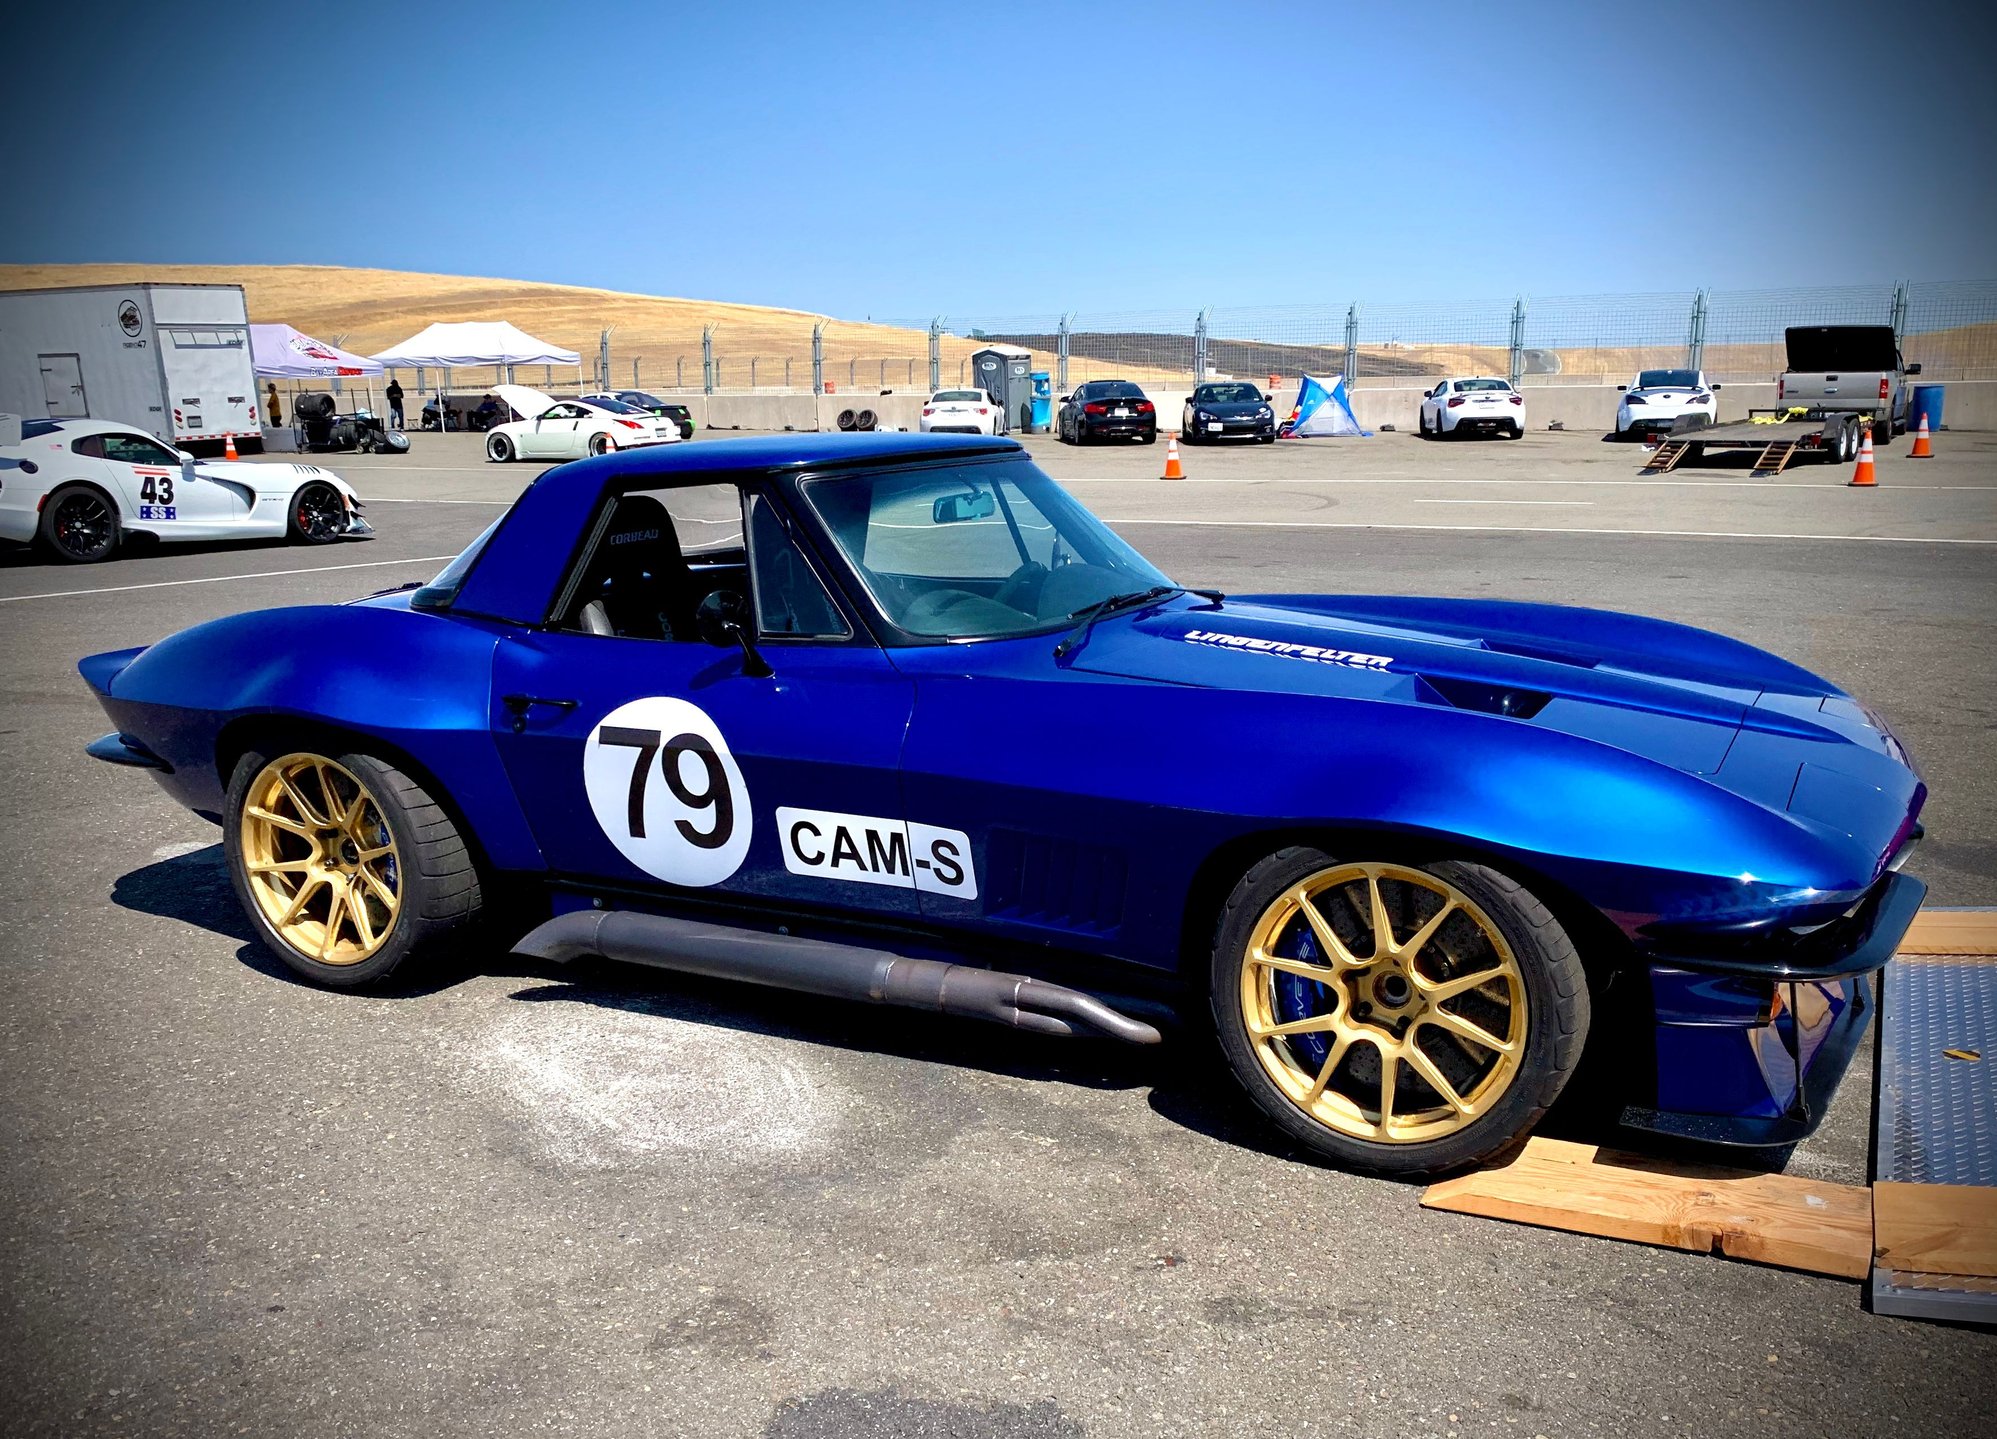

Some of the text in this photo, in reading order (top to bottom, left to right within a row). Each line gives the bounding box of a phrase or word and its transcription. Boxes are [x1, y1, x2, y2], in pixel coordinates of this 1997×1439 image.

[140, 476, 175, 505] 43
[150, 506, 167, 519] SS
[610, 529, 659, 545] CORBEAU
[1184, 630, 1394, 668] LINGENFELTER
[599, 725, 734, 849] 79
[790, 820, 965, 887] CAM-S
[1294, 942, 1325, 1053] CORVEE
